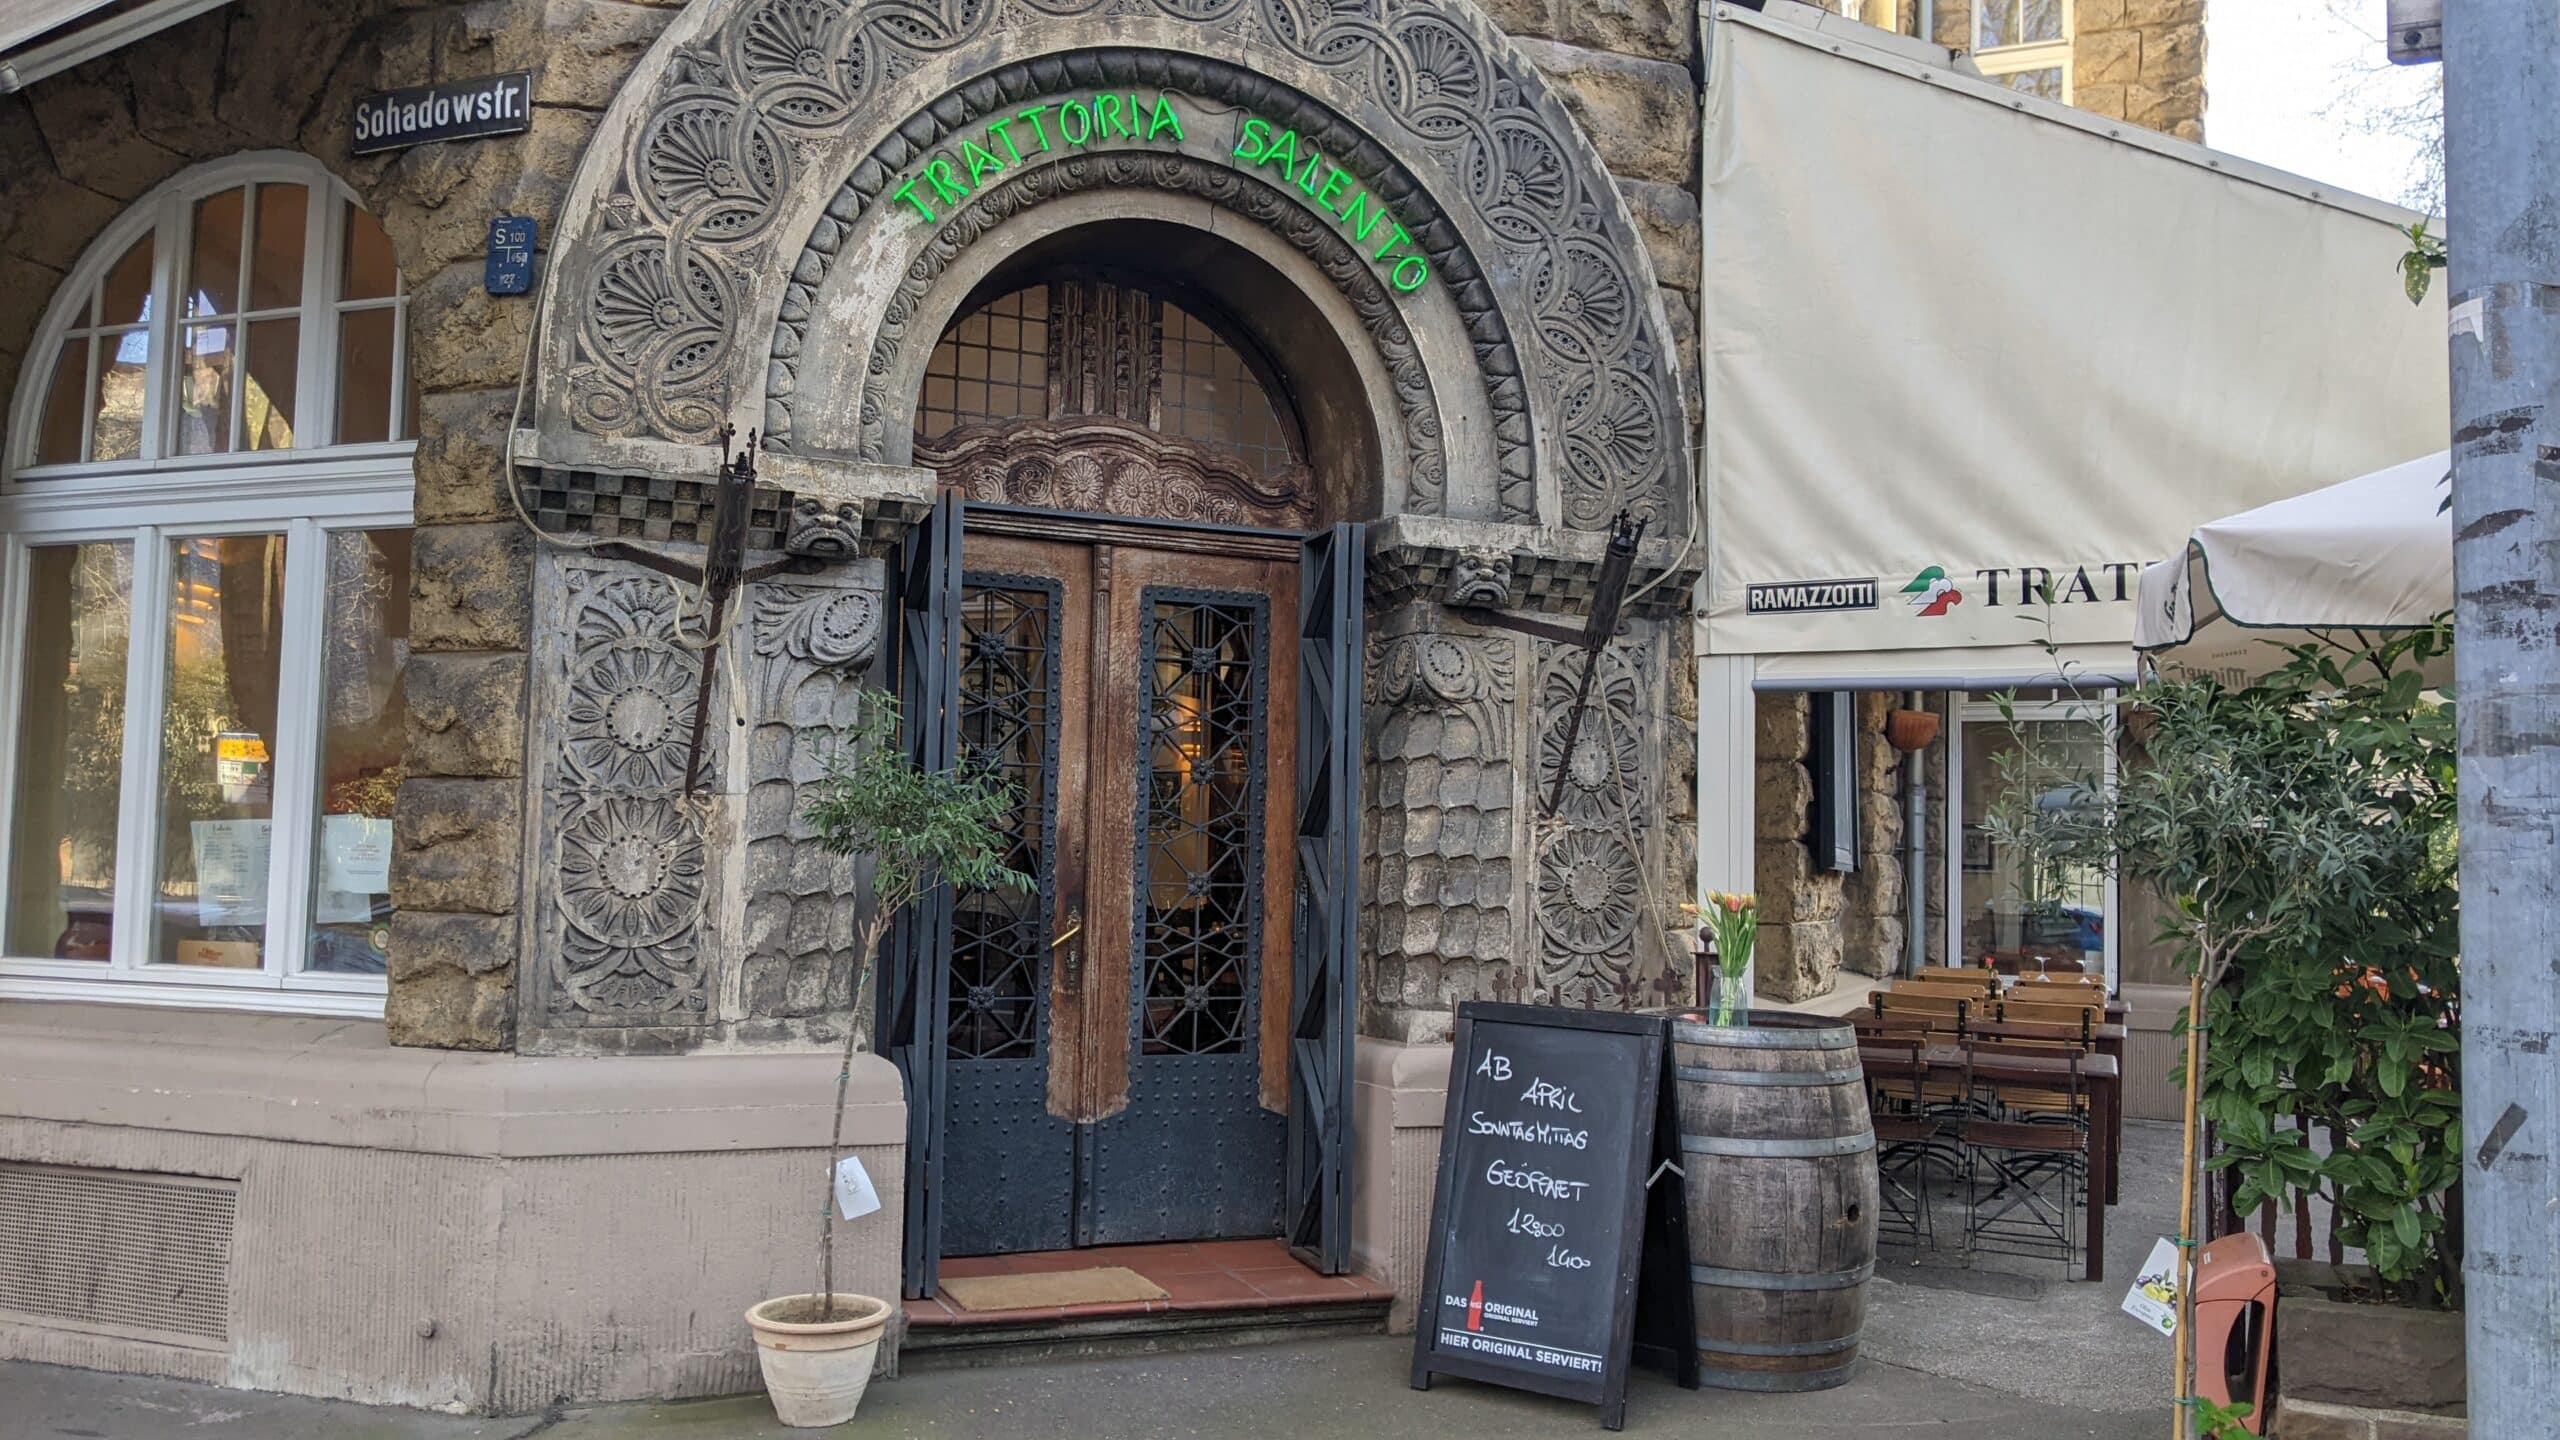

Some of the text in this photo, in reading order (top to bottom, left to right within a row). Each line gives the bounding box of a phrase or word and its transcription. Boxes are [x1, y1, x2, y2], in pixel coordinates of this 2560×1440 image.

[893, 94, 1428, 291] TRATTORIA SALENTO
[1751, 583, 1873, 610] RAMAZZOTTI
[1976, 561, 2161, 607] TRAT
[1476, 1048, 1513, 1081] AB
[1486, 1159, 1590, 1202] GEÖFFNET
[1506, 1207, 1566, 1238] 12:00
[1445, 1294, 1467, 1308] DAS
[1484, 1301, 1539, 1321] ORIGINAL
[1440, 1332, 1603, 1373] HIER ORIGINAL SERVIERT!
